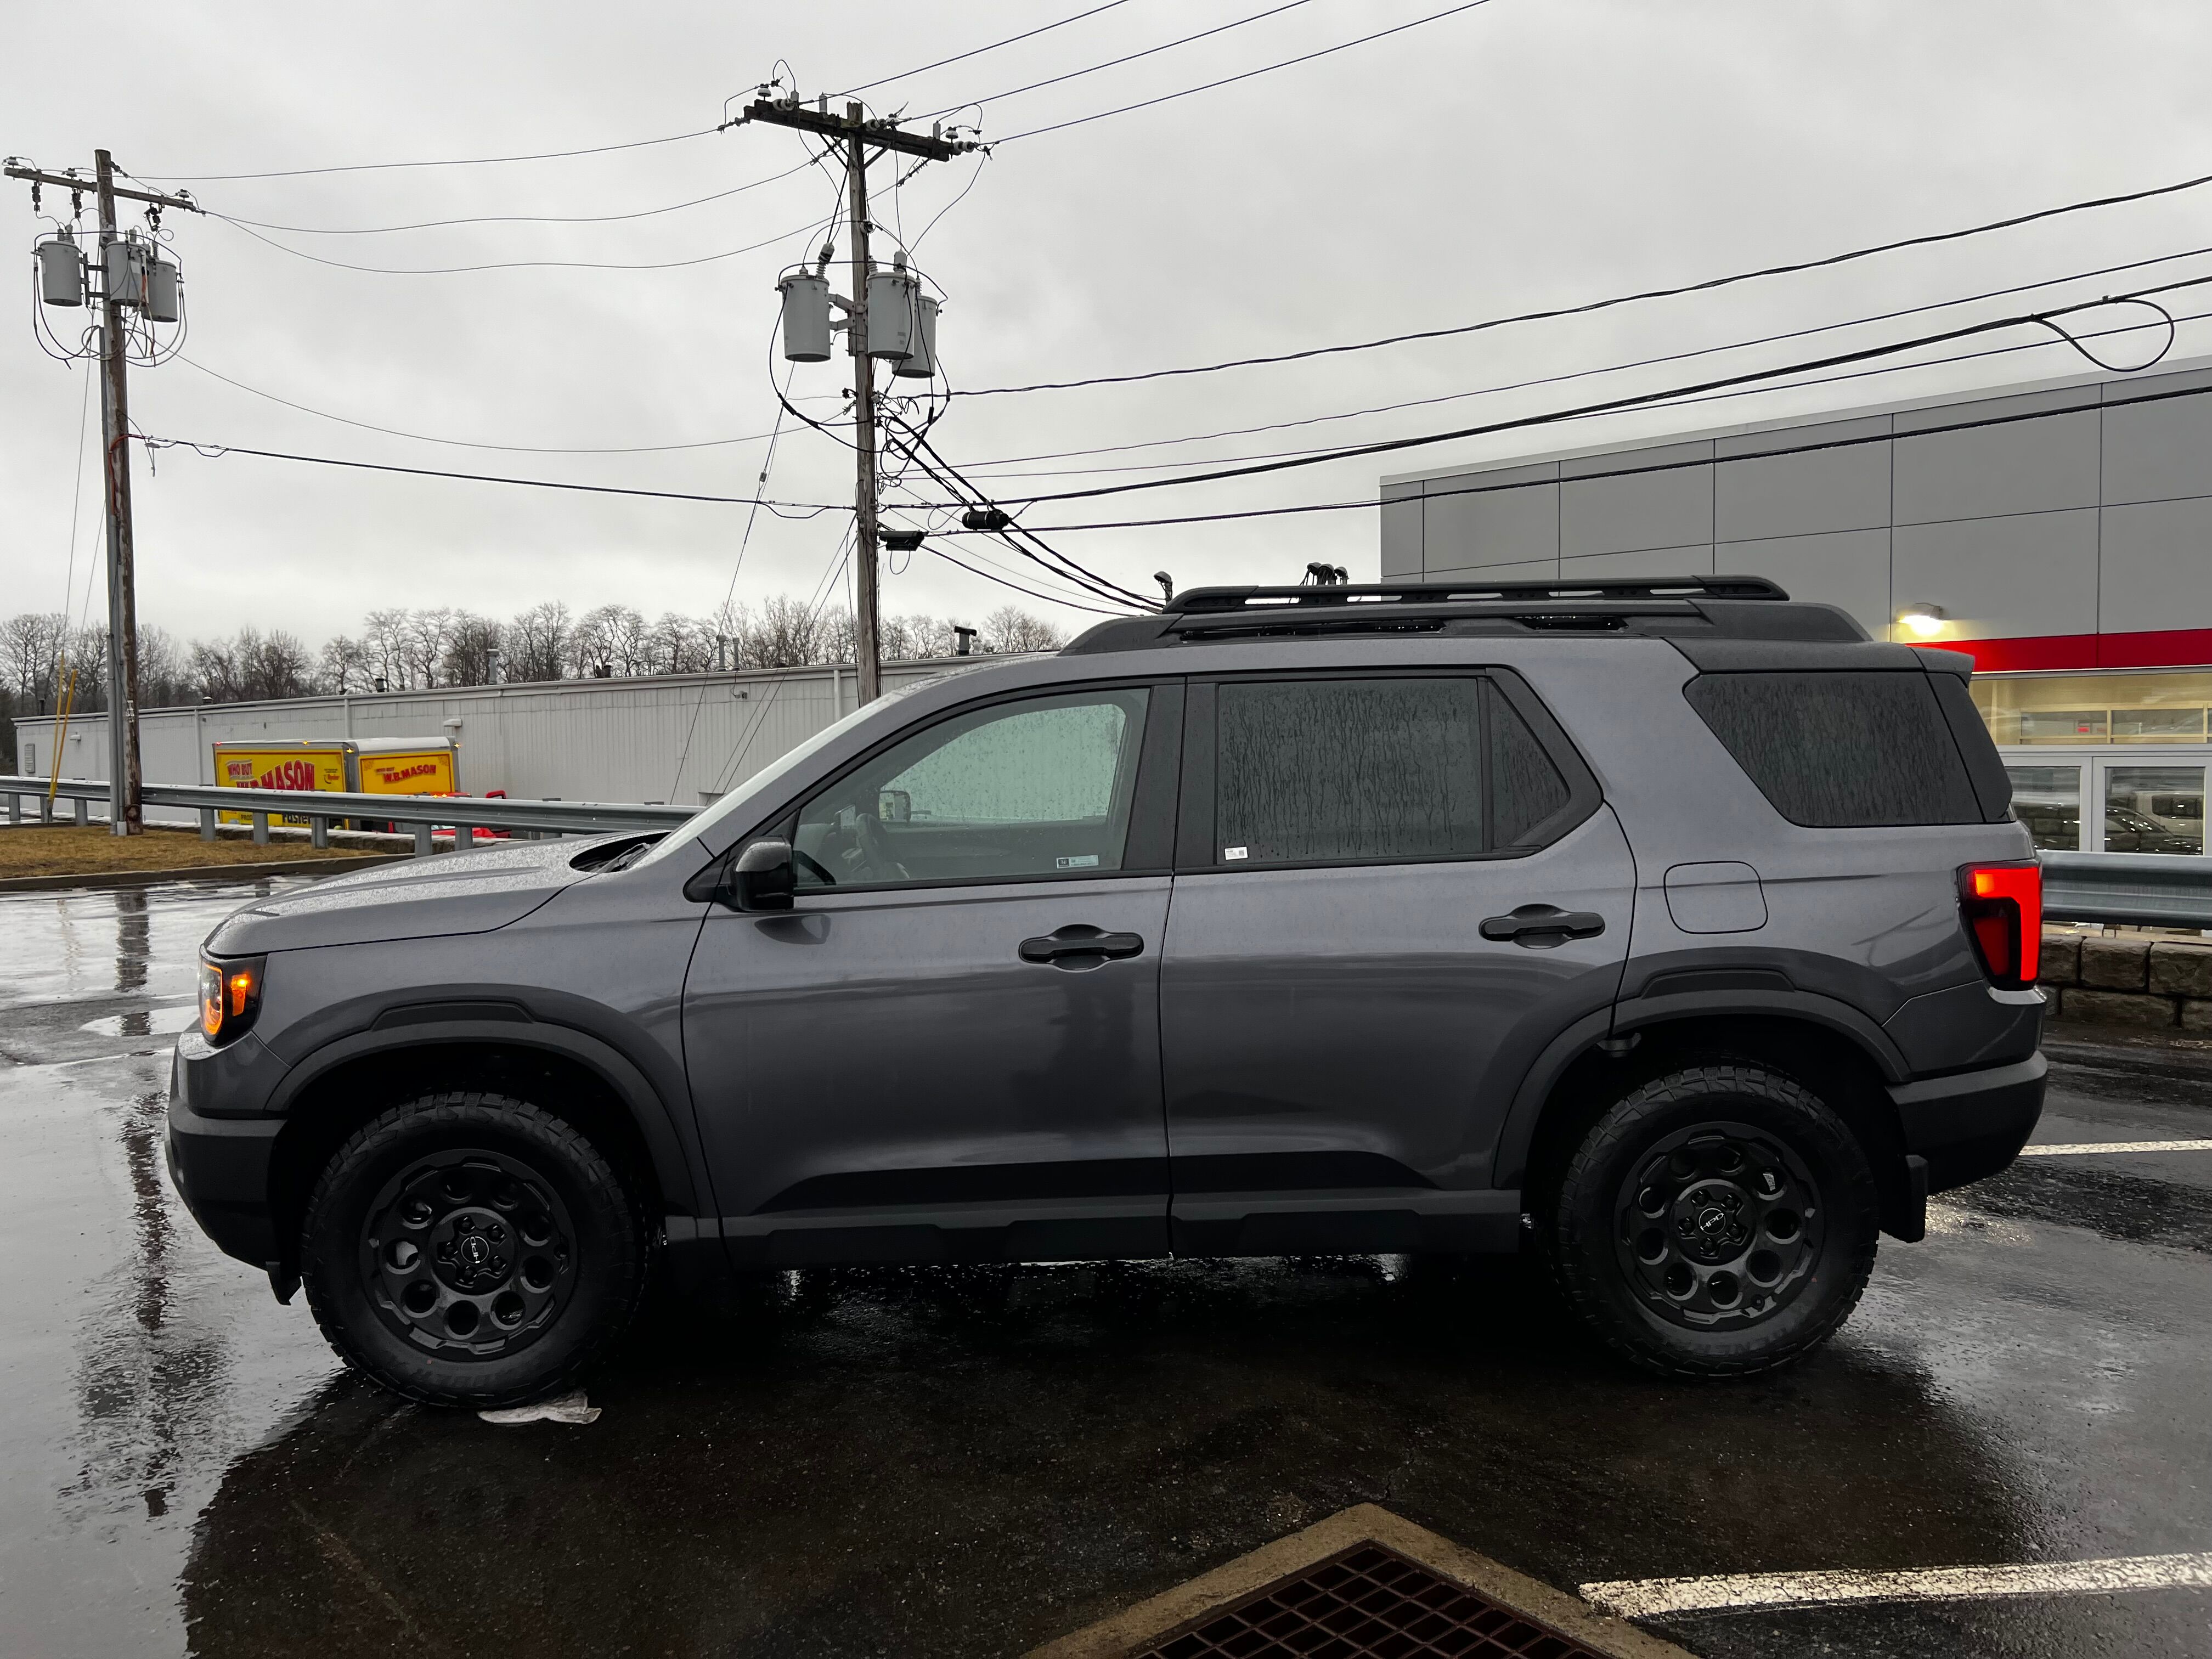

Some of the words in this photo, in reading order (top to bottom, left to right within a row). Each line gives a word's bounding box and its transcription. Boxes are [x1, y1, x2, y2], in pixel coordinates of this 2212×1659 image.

[228, 763, 240, 776] WHO
[241, 763, 252, 775] BUT
[261, 760, 315, 791] MASON
[400, 764, 436, 778] MASON
[1700, 1213, 1724, 1231] HPD
